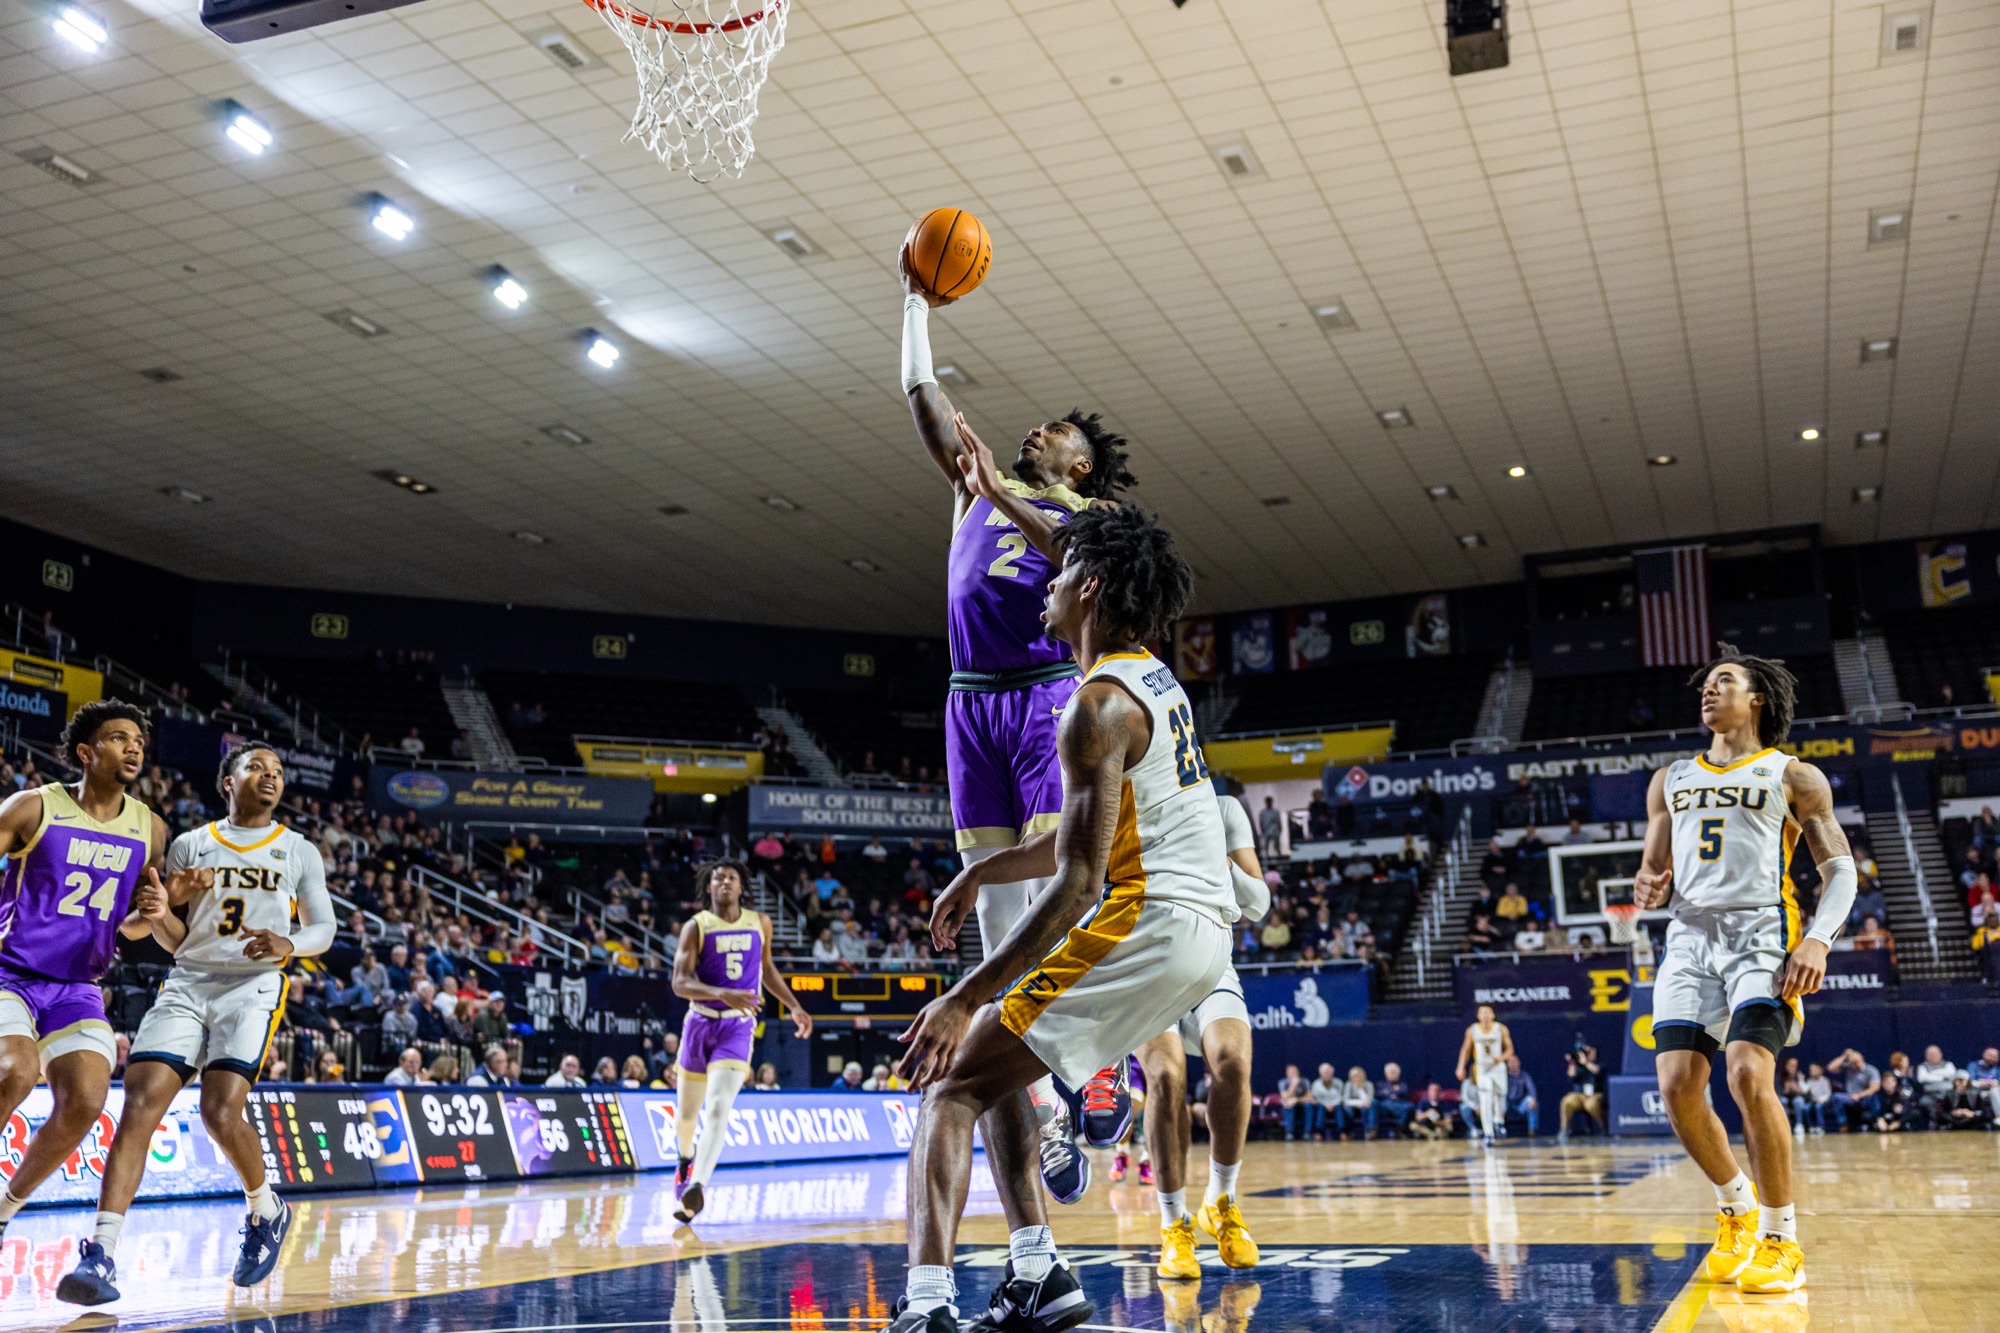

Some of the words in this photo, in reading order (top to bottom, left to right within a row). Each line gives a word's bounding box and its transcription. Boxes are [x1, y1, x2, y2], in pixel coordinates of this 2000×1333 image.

[987, 533, 1027, 578] 2
[768, 791, 820, 807] HOME
[824, 794, 845, 808] OF
[855, 795, 886, 810] THE
[892, 797, 933, 812] BEST
[1672, 786, 1768, 814] ETSU
[802, 809, 896, 827] SOUTHERN
[66, 838, 132, 873] WCU
[1699, 818, 1725, 862] 5
[58, 871, 119, 922] 24
[213, 867, 282, 891] TSU
[218, 897, 244, 938] 3
[726, 953, 743, 981] 5
[338, 1100, 367, 1114] ETSU
[421, 1094, 495, 1136] 9:32
[344, 1122, 381, 1160] 48
[538, 1119, 570, 1152] 56
[761, 1107, 870, 1145] HORIZON
